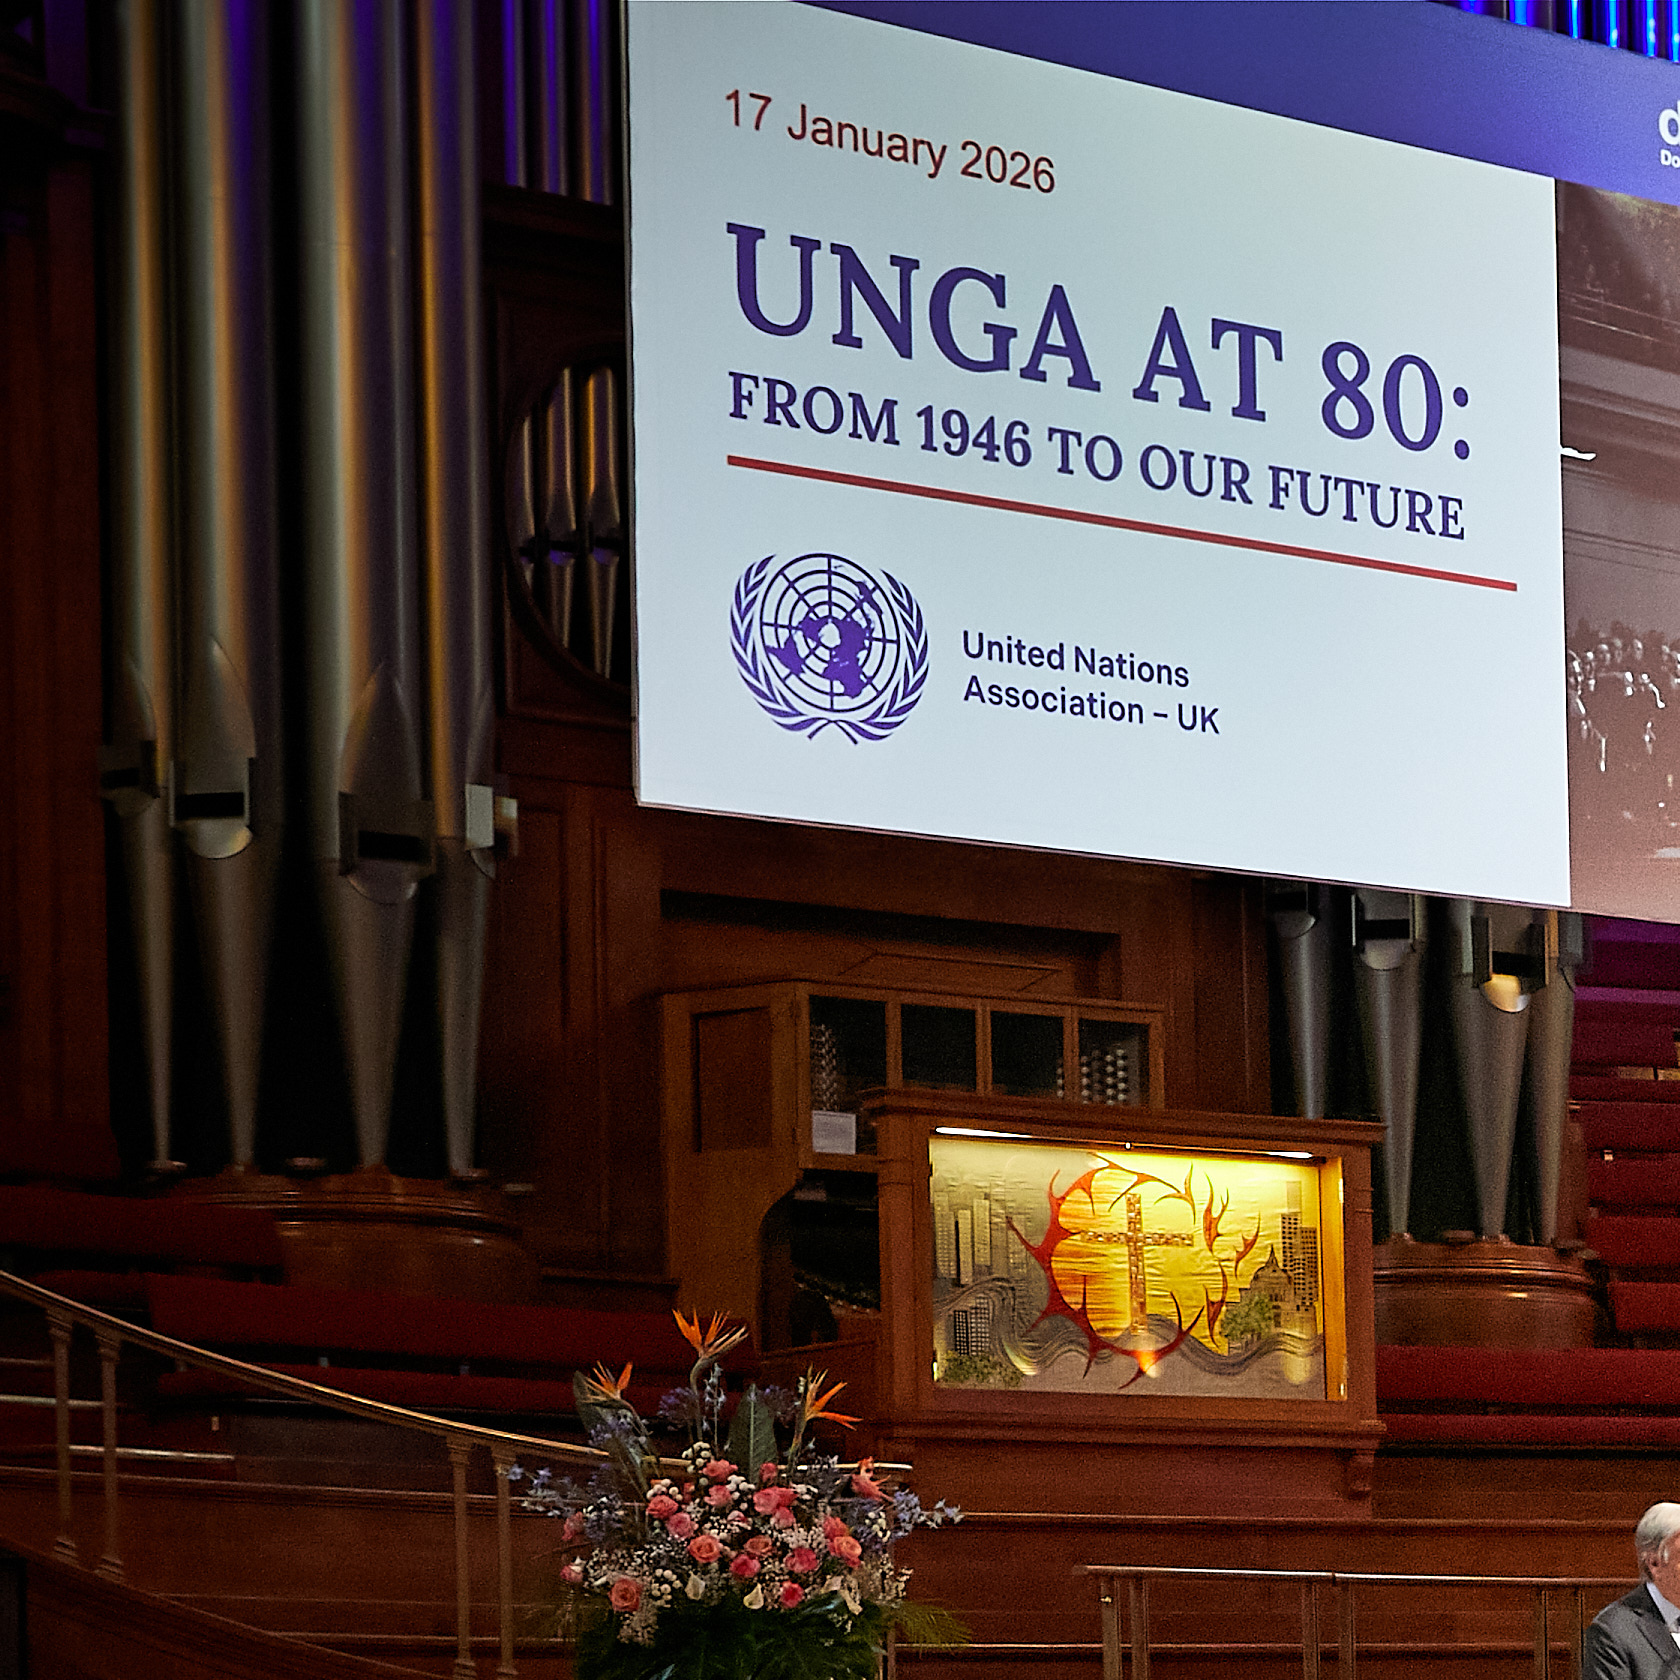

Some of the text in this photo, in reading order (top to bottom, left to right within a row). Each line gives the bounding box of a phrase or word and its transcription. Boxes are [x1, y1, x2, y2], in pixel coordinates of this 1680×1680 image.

[724, 88, 1056, 194] 17 January 2026
[1660, 149, 1680, 168] Do
[725, 221, 1470, 461] UNGA AT 80:
[727, 370, 1465, 541] FROM 1946 TO OUR FUTURE
[962, 629, 1190, 688] United Nations
[963, 674, 1144, 725] Association
[1177, 703, 1220, 735] UK
